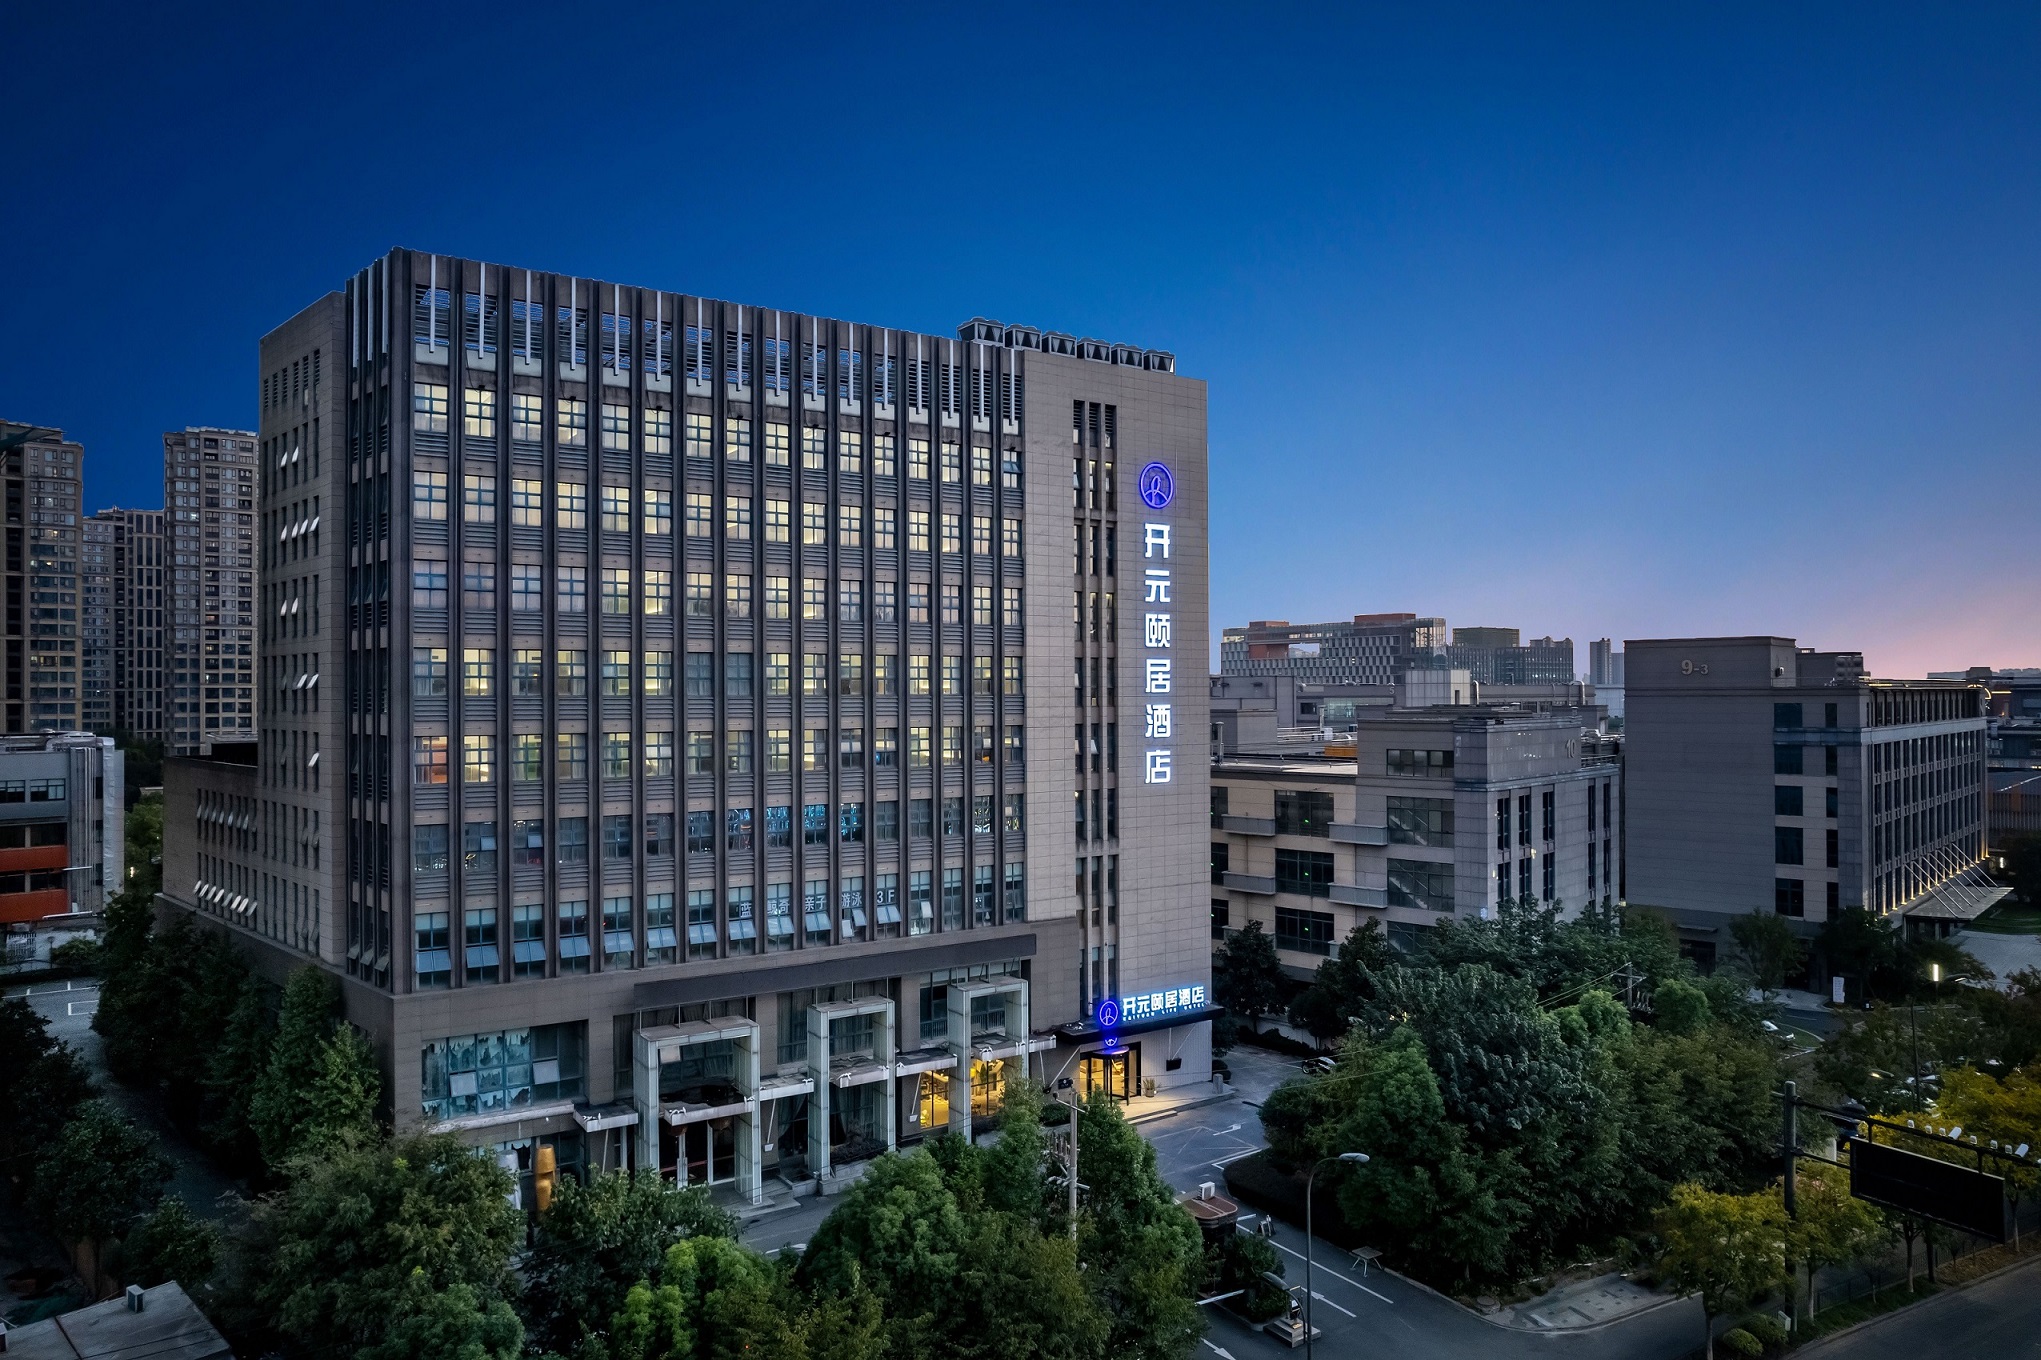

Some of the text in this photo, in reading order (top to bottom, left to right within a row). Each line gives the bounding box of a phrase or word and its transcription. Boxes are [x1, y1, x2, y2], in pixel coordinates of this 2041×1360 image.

[1144, 522, 1171, 784] 开元颐居酒店
[1681, 659, 1709, 675] 9-3
[1389, 686, 1395, 695] 5
[1565, 739, 1577, 758] 10
[1122, 986, 1204, 1016] 开元颐居酒店
